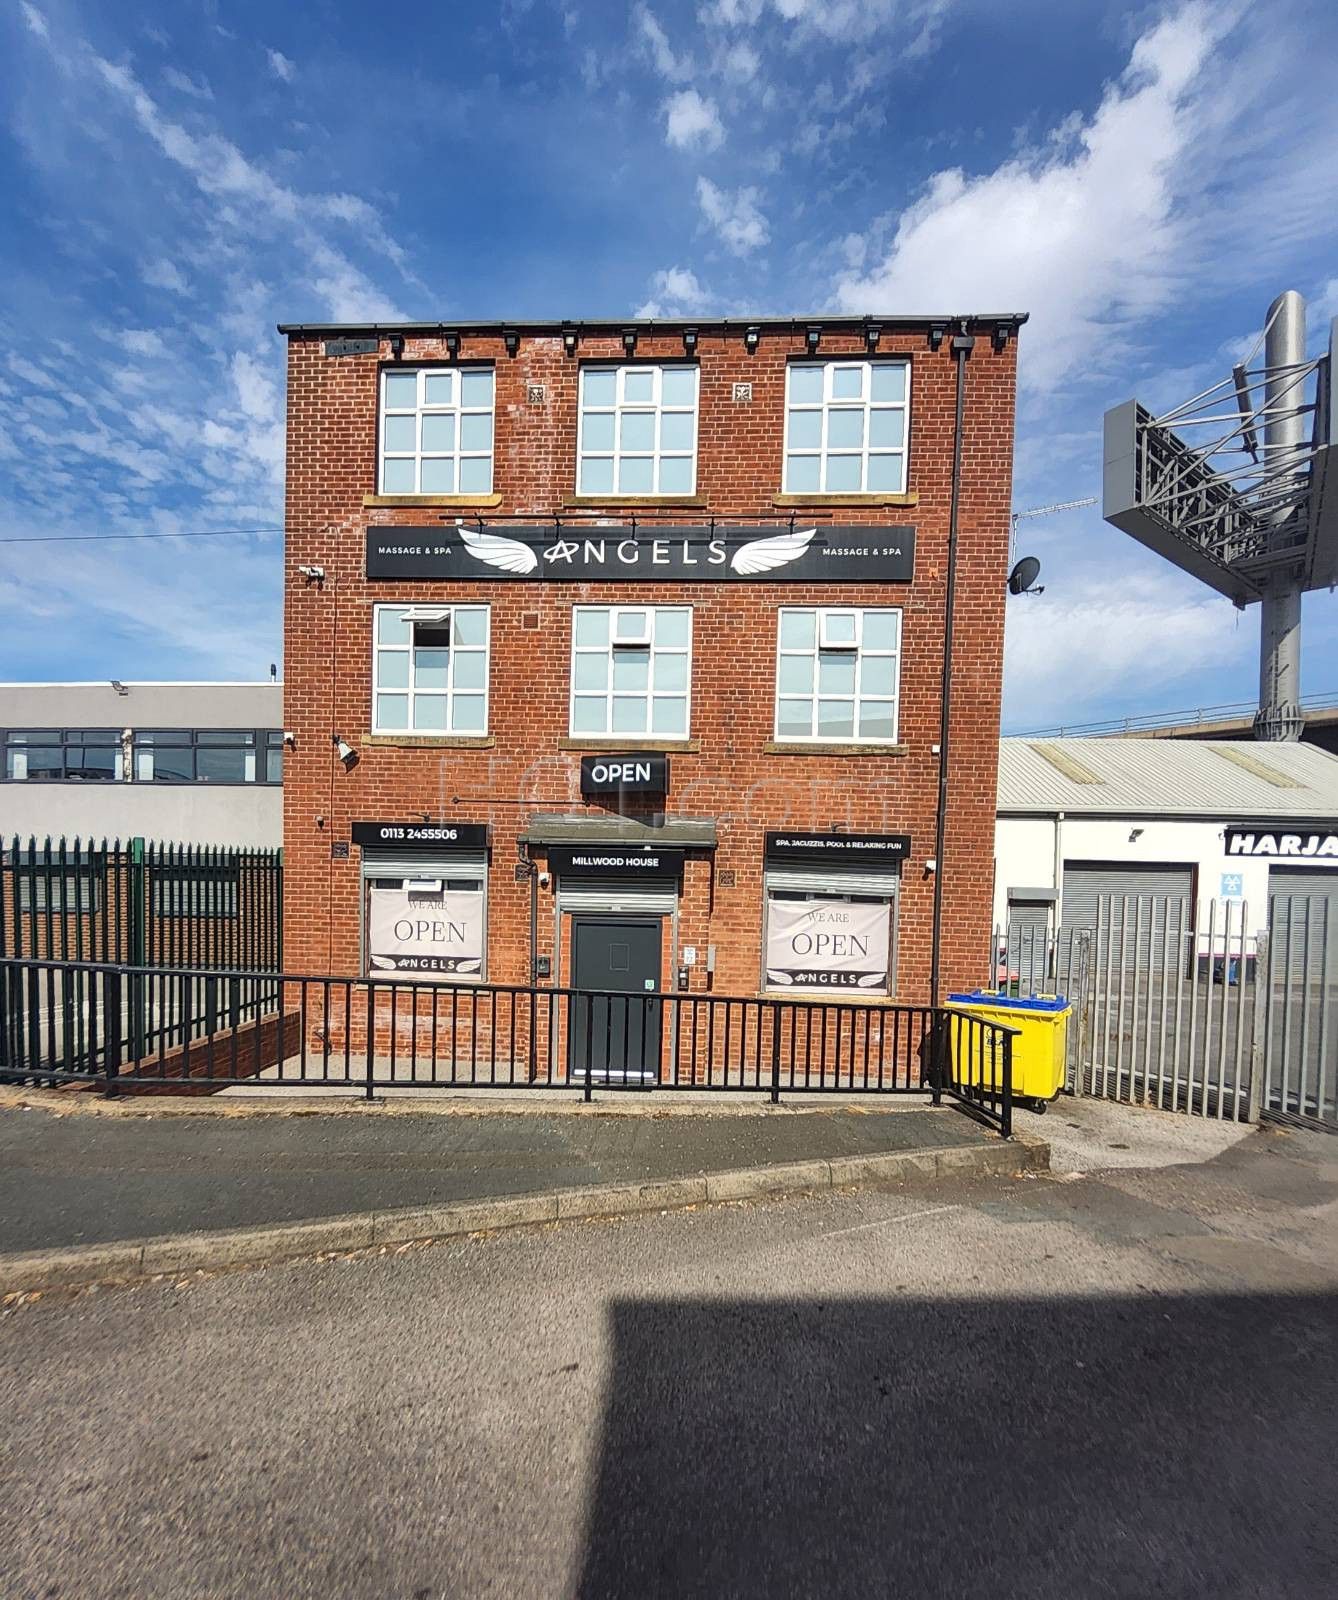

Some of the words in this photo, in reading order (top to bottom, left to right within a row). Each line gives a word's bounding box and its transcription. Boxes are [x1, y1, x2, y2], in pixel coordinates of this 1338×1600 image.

[378, 546, 421, 555] MASSAGE
[424, 546, 431, 555] &
[433, 546, 452, 555] SPA
[543, 539, 727, 565] ANGELS
[822, 547, 869, 556] MASSAGE
[872, 547, 879, 556] &
[882, 547, 902, 556] SPA
[591, 762, 651, 783] OPEN
[380, 827, 405, 839] 0113
[406, 828, 458, 840] 2455506
[775, 839, 791, 847] SPA,
[791, 840, 826, 848] JACUZZIS,
[826, 841, 845, 849] POOL
[845, 841, 852, 849] &
[852, 841, 887, 850] RELAXING
[887, 842, 902, 850] FUN
[572, 856, 624, 867] MILLWOOD
[625, 857, 659, 867] HOUSE
[408, 900, 425, 910] WE
[427, 900, 447, 910] ARE
[807, 912, 826, 922] WE
[828, 912, 850, 923] ARE
[394, 919, 467, 943] OPEN
[791, 932, 870, 957] OPEN
[398, 958, 455, 970] ANGELS
[795, 973, 857, 985] ANGELS
